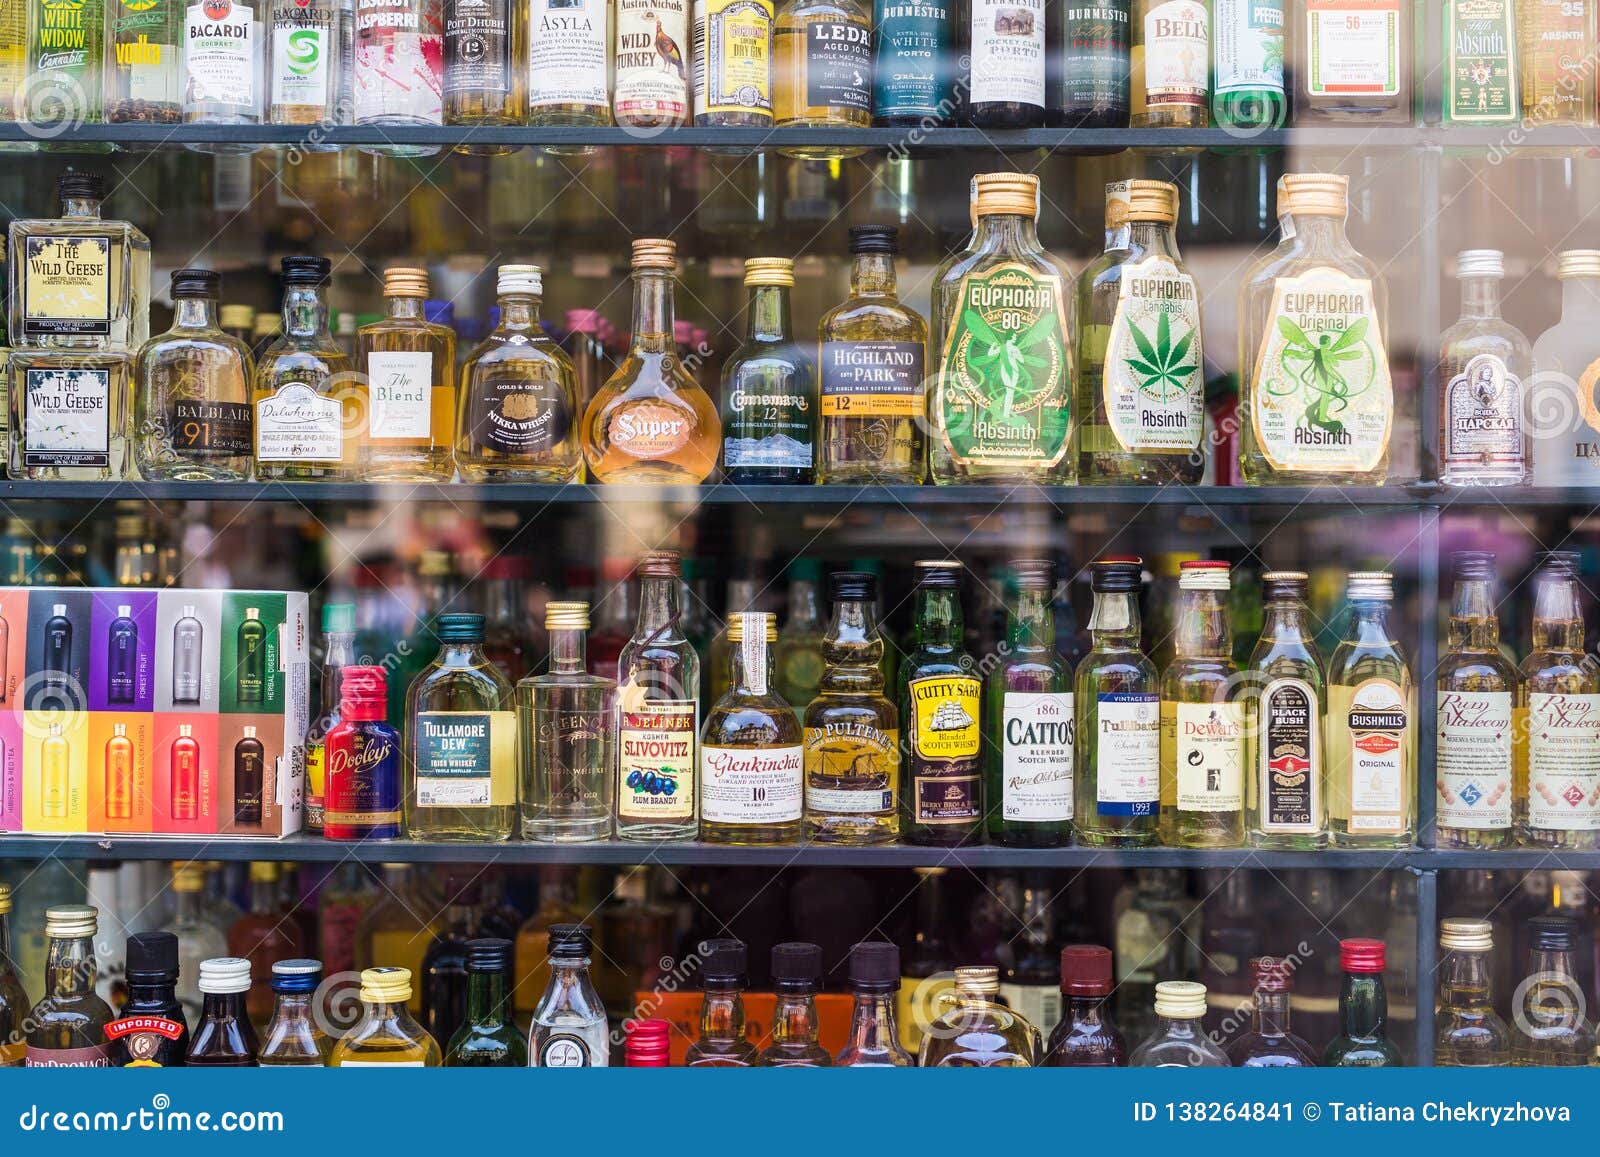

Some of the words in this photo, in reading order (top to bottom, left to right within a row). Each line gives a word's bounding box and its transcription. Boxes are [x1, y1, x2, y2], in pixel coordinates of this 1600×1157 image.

[621, 0, 649, 10] Austin
[650, 0, 682, 12] Nichols
[884, 6, 946, 20] BURMESTER
[1560, 2, 1584, 16] 35
[43, 10, 82, 28] WHITE
[448, 20, 466, 30] POIT
[468, 17, 504, 28] DHUBH
[540, 16, 592, 32] ASYLA
[1068, 9, 1128, 23] BURMESTER
[1346, 16, 1361, 30] 56
[190, 23, 248, 39] BACARDÍ
[273, 22, 292, 30] BIG
[293, 21, 336, 31] APPLE
[1155, 19, 1208, 41] BELL'S
[40, 29, 86, 49] WIDOW
[621, 33, 650, 49] WILD
[892, 38, 938, 48] WHITE
[984, 38, 1020, 46] JOCKEY
[1023, 41, 1041, 50] CLUB
[1541, 32, 1584, 41] ABSINTH
[116, 34, 161, 65] vodka
[466, 42, 479, 52] 12
[734, 44, 750, 57] DRY
[751, 45, 762, 58] GIN
[824, 43, 849, 51] AGED
[990, 47, 1038, 58] PORTO
[38, 50, 84, 69] Cannabis
[618, 52, 658, 70] TURKEY
[56, 243, 79, 259] THE
[30, 260, 61, 276] WILD
[66, 260, 105, 276] GEESE
[1131, 279, 1193, 300] EUPHORIA
[971, 288, 1051, 308] EUPHORIA
[1284, 294, 1364, 314] EUPHORIA
[1144, 300, 1183, 314] Cannabis
[1002, 312, 1020, 330] 80
[1300, 314, 1348, 332] Original
[834, 350, 914, 366] HIGHLAND
[388, 373, 412, 387] The
[855, 368, 895, 382] PARK
[56, 376, 79, 392] THE
[30, 393, 61, 408] WILD
[66, 393, 104, 409] GEESE
[376, 388, 424, 402] Blend
[835, 396, 850, 411] 12
[177, 404, 250, 421] BALBLAIR
[488, 410, 518, 430] NIKKA
[519, 408, 553, 430] WHISKY
[764, 408, 777, 420] 12
[1142, 410, 1187, 428] Absinth
[616, 414, 684, 441] Super
[978, 422, 1036, 440] Absinth
[1458, 418, 1514, 432] ЦАРСКАЯ
[184, 422, 208, 446] 91
[1294, 428, 1352, 445] Absinth
[916, 684, 955, 700] CUTTY
[958, 683, 980, 698] SARK
[1037, 704, 1059, 715] 1861
[1272, 708, 1306, 716] BLACK
[1439, 694, 1490, 718] Rum
[1539, 695, 1591, 720] Rum
[636, 715, 691, 728] JELÍNEK
[1184, 720, 1240, 736] Dewar's
[1275, 717, 1304, 725] BUSH
[1352, 715, 1402, 726] BUSHMILLS
[1446, 712, 1508, 730] Malecon
[424, 722, 485, 738] TULLAMORE
[939, 733, 966, 741] Blended
[1006, 718, 1074, 746] CATTO'S
[442, 738, 467, 750] DEW
[624, 740, 688, 757] SLIVOVITZ
[923, 741, 951, 750] SCOTCH
[954, 740, 976, 749] WHISKY
[330, 740, 392, 776] Dooley's
[708, 752, 800, 778] Glenkinchie
[1018, 756, 1046, 764] SCOTCH
[1359, 760, 1396, 768] ORIGINAL
[633, 795, 649, 804] PLUM
[651, 796, 677, 805] BRANDY
[753, 788, 765, 801] 10
[1131, 803, 1150, 812] 1993
[114, 1020, 176, 1032] IMPORTED
